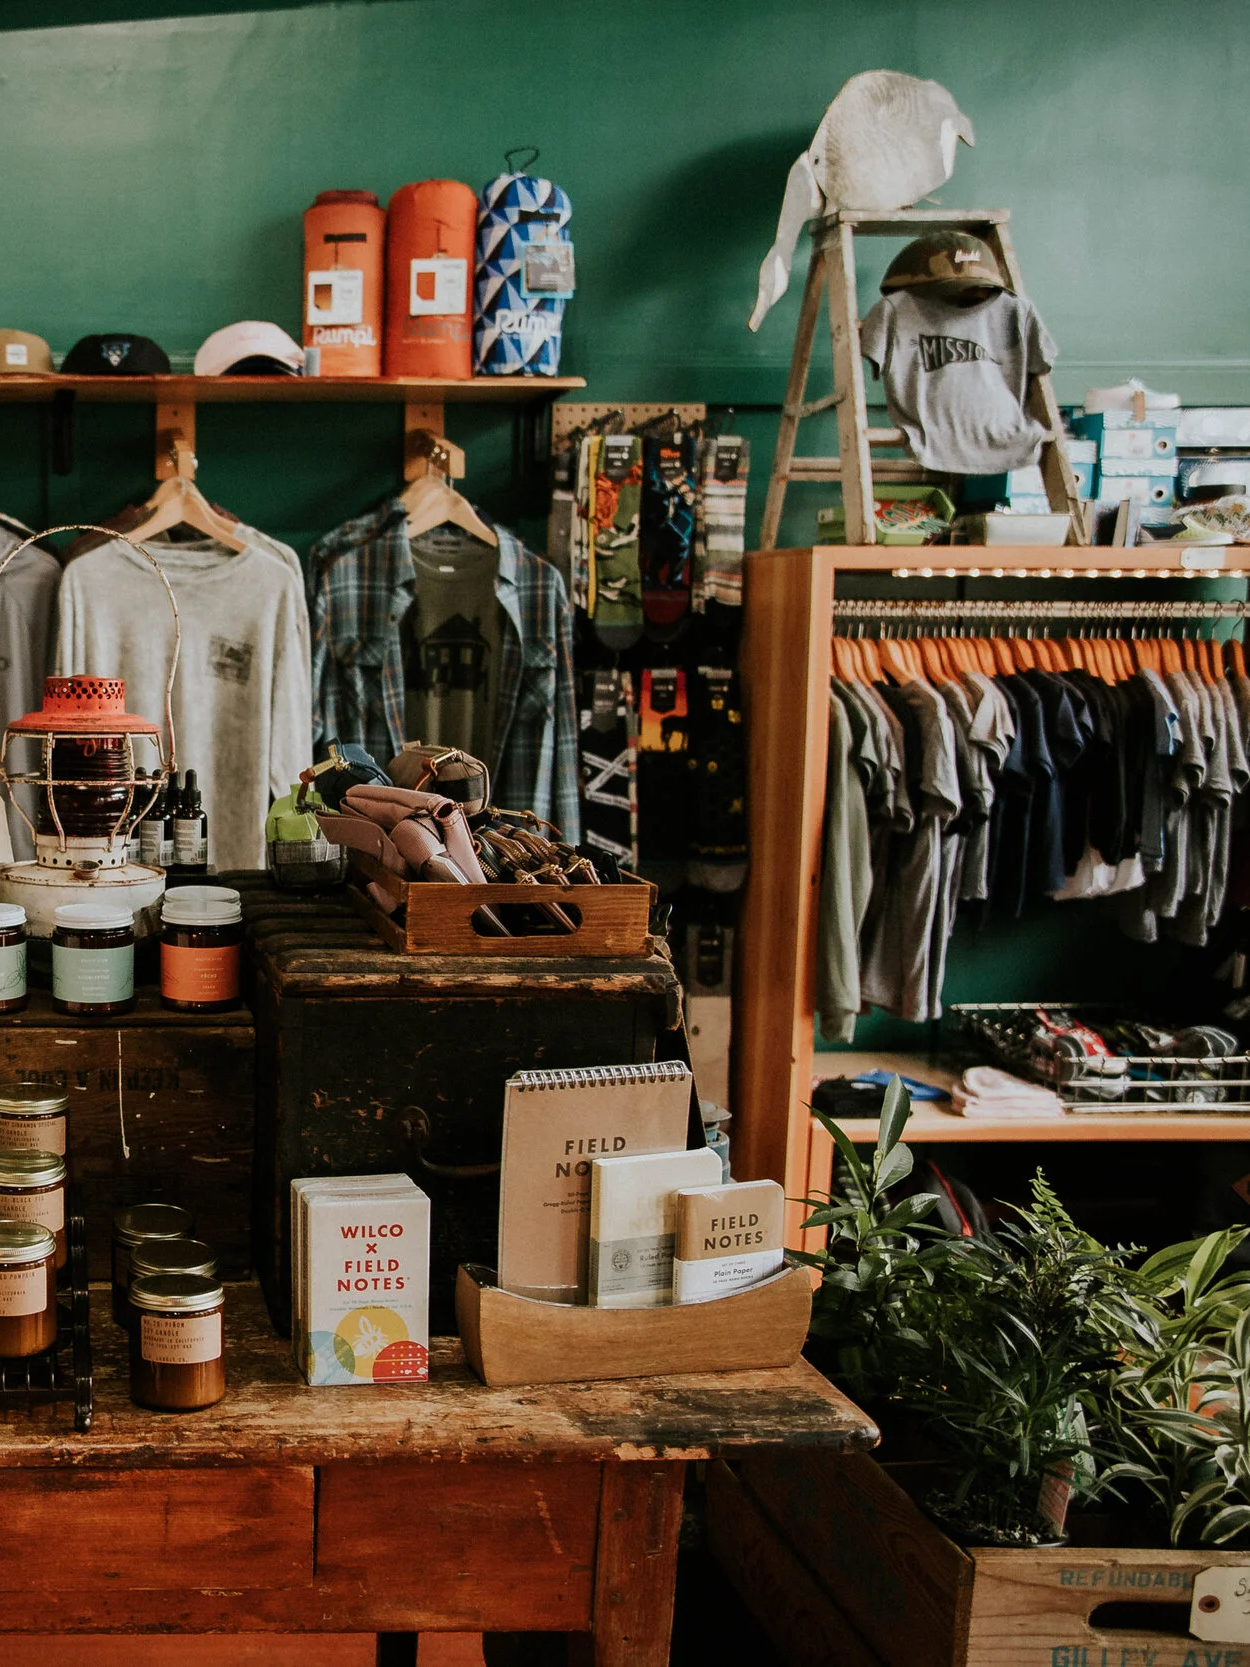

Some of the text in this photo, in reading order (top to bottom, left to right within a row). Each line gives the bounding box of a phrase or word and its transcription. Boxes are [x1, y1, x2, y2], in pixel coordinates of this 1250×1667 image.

[313, 326, 377, 348] Rumpl
[565, 1137, 626, 1155] FIELD
[711, 1214, 758, 1231] FIELD
[341, 1224, 403, 1238] WILCO
[704, 1231, 763, 1250] NOTES
[639, 1252, 660, 1261] Ruled
[345, 1259, 399, 1273] FIELD
[714, 1267, 753, 1277] Plain Paper
[338, 1277, 405, 1292] NOTES
[1059, 1568, 1192, 1589] REFUNDABL
